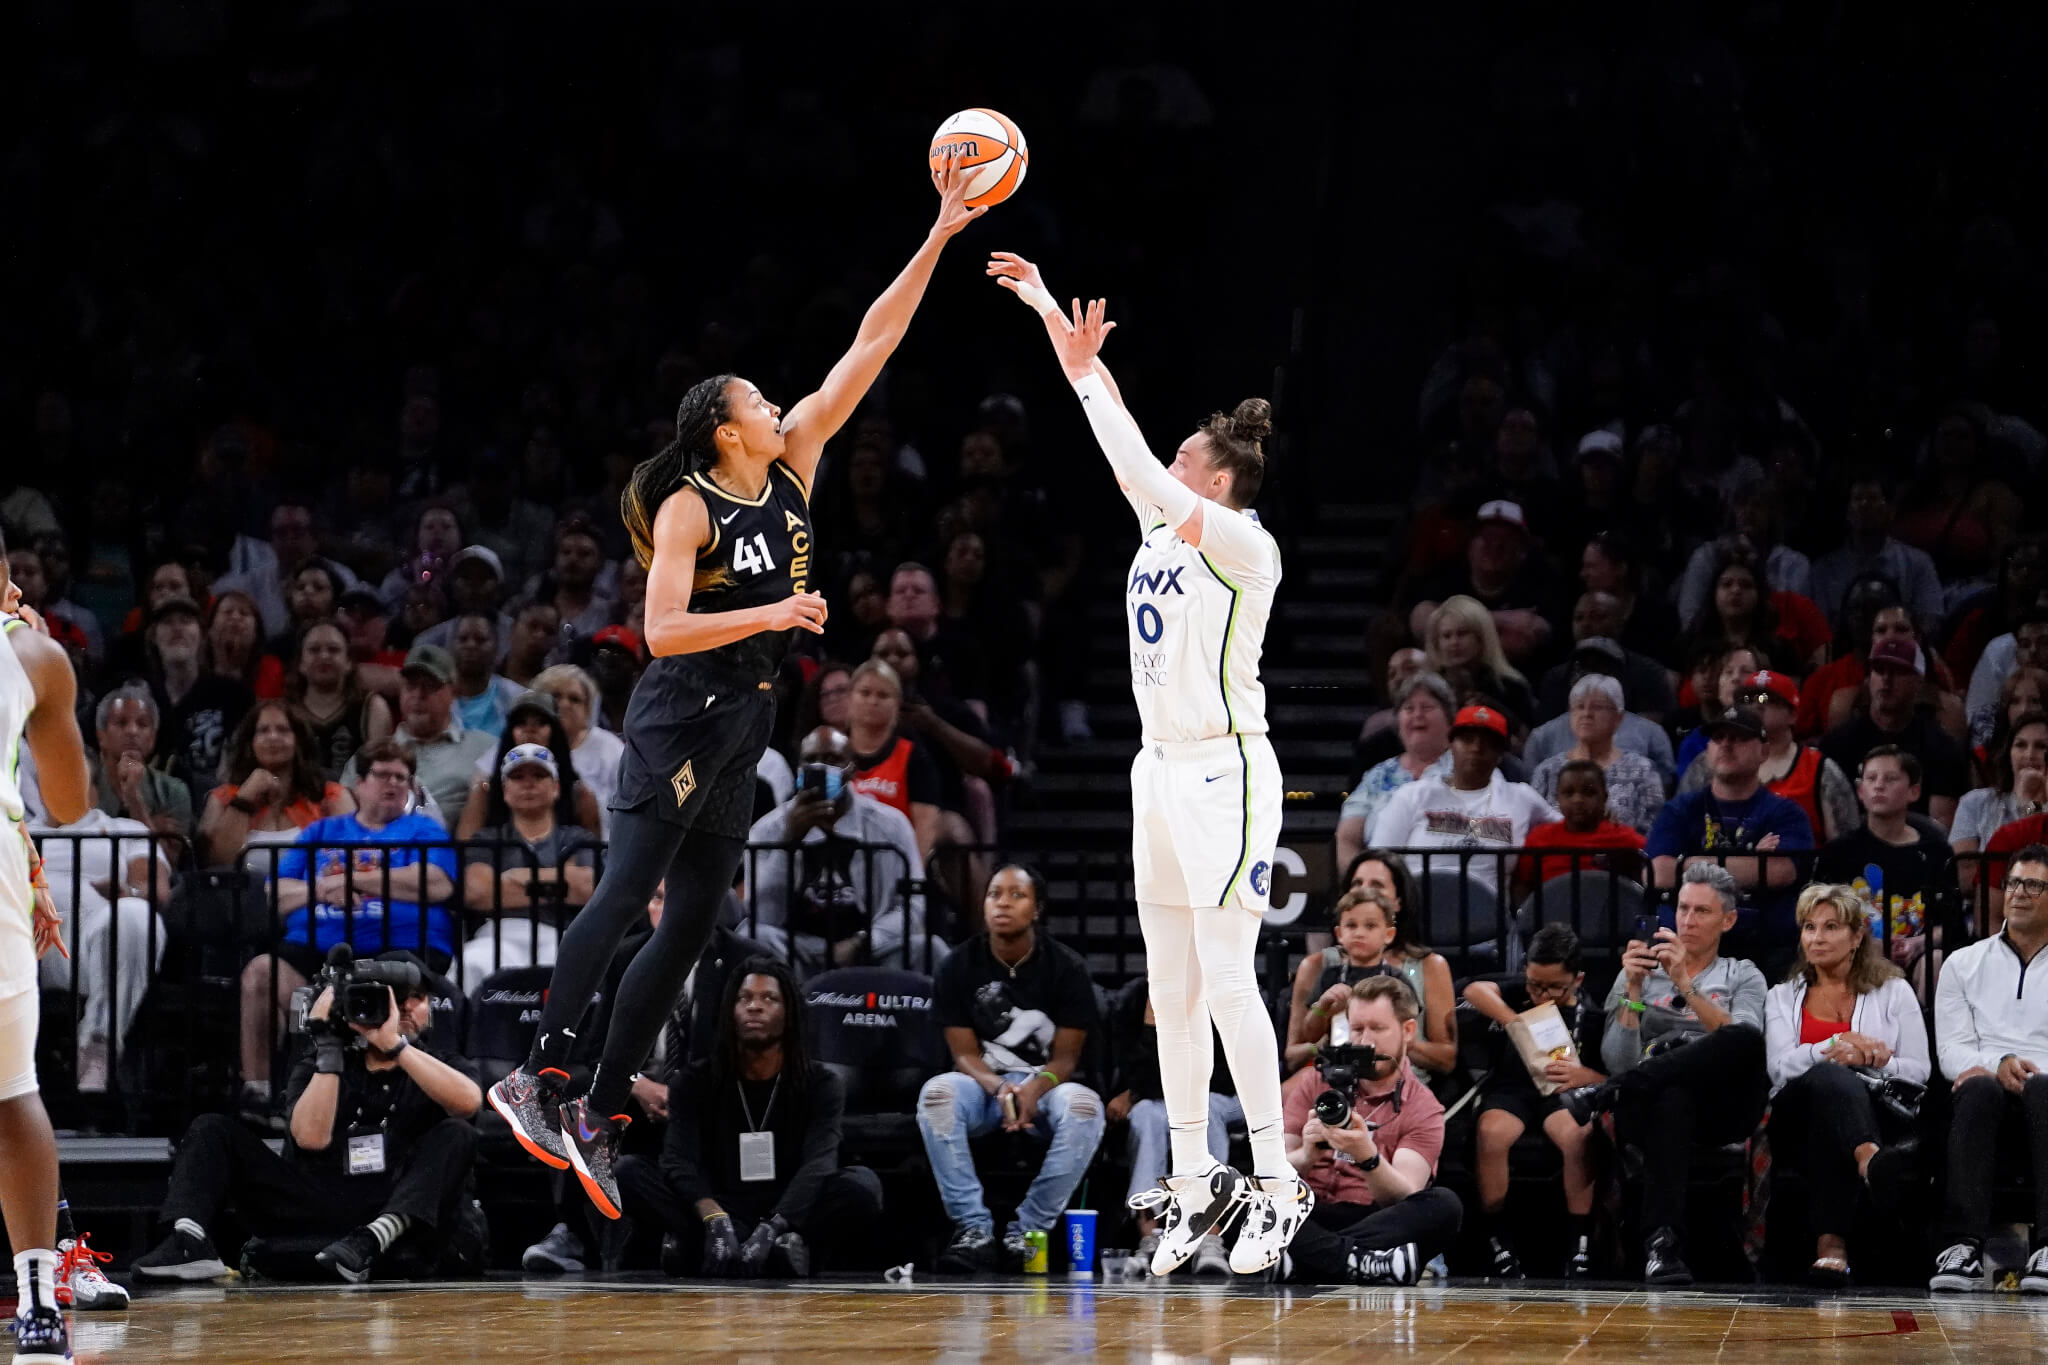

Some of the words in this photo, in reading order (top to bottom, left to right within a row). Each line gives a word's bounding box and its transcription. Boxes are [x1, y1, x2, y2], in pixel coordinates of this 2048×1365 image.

[733, 532, 776, 575] 41
[1128, 565, 1186, 595] YNX
[1132, 602, 1163, 644] 0
[842, 1012, 898, 1027] ARENA
